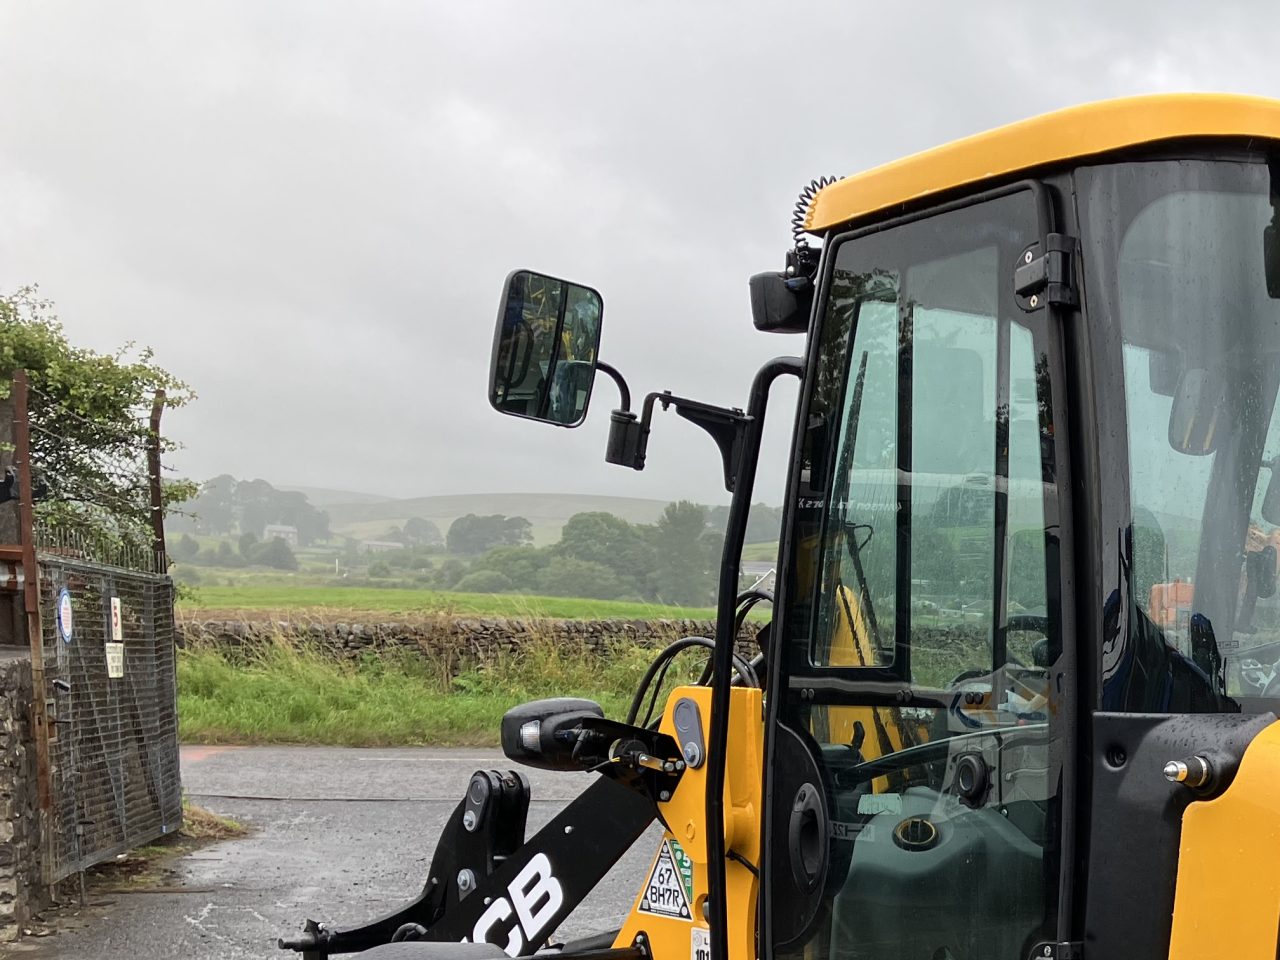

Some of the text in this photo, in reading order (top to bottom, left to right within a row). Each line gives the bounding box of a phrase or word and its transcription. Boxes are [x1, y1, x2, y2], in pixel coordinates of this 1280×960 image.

[658, 867, 673, 885] 67
[460, 853, 563, 958] CB
[650, 886, 680, 908] BH7R
